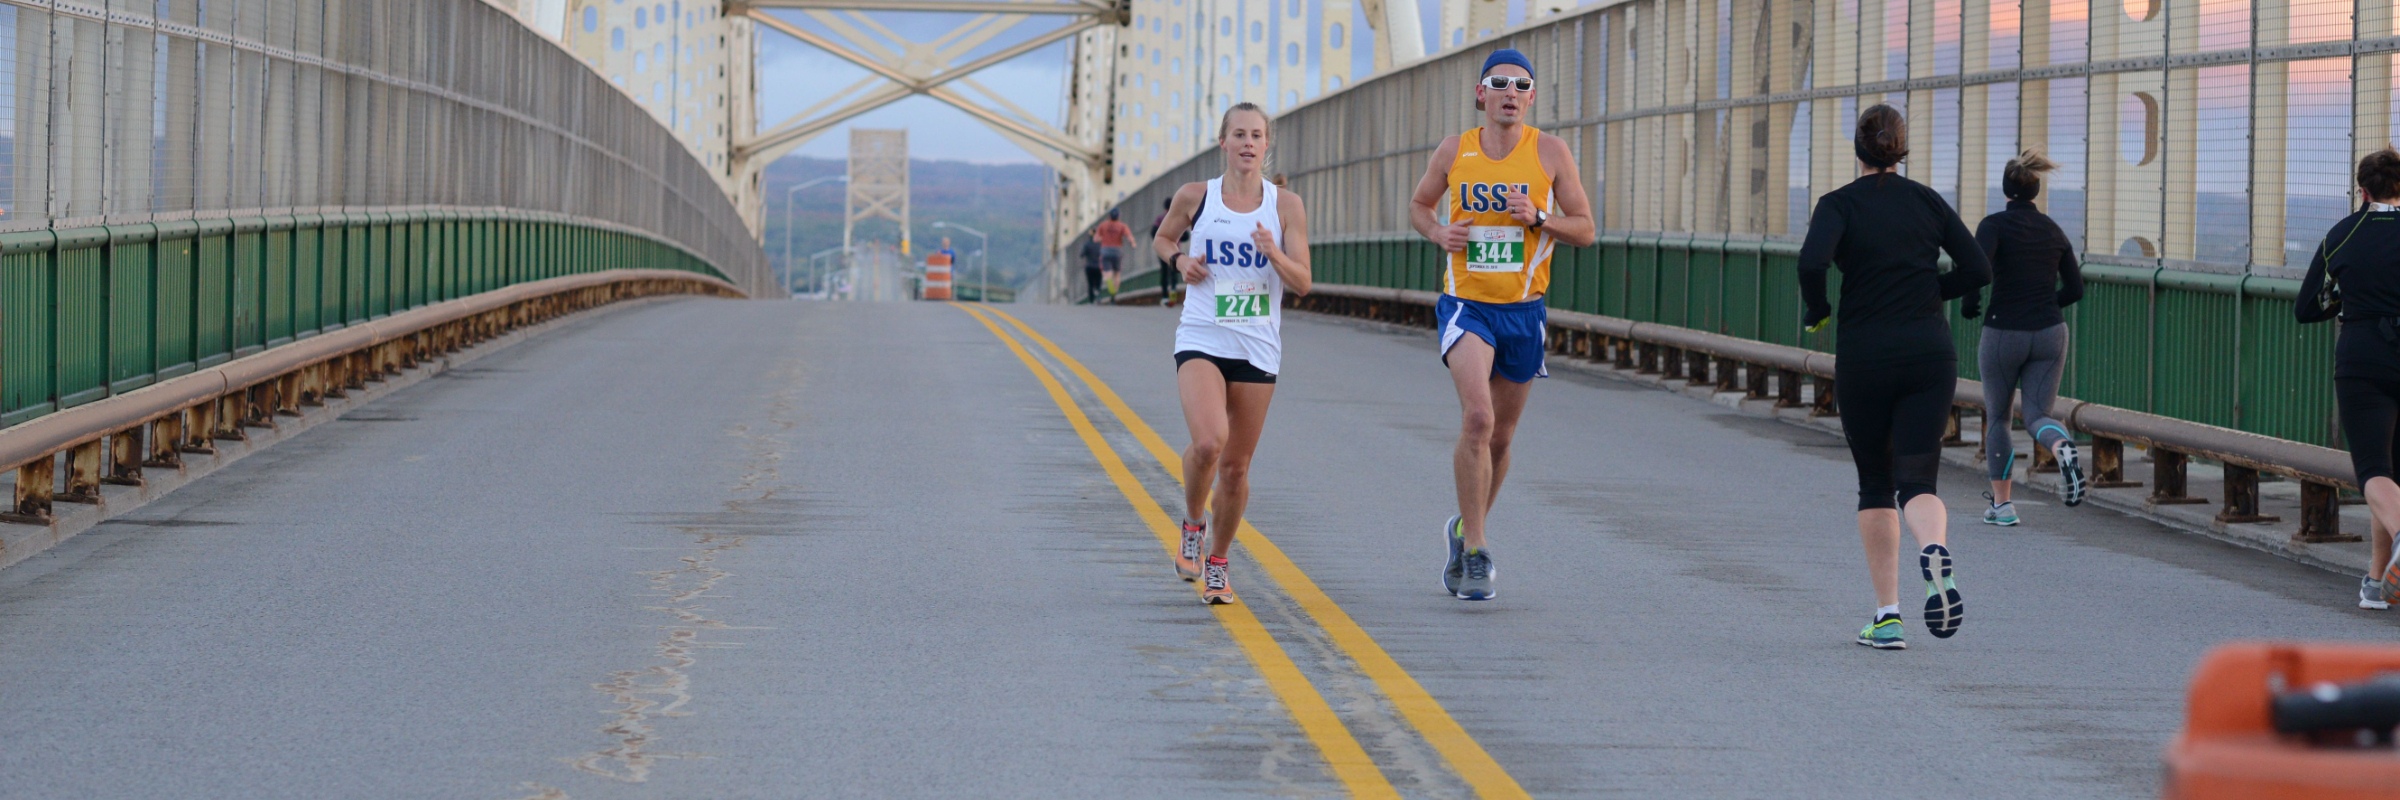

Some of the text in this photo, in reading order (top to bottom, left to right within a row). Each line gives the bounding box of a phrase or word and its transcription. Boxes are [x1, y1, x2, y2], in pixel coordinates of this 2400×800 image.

[1460, 182, 1529, 213] LSS
[1476, 242, 1513, 263] 344
[1225, 295, 1261, 316] 274
